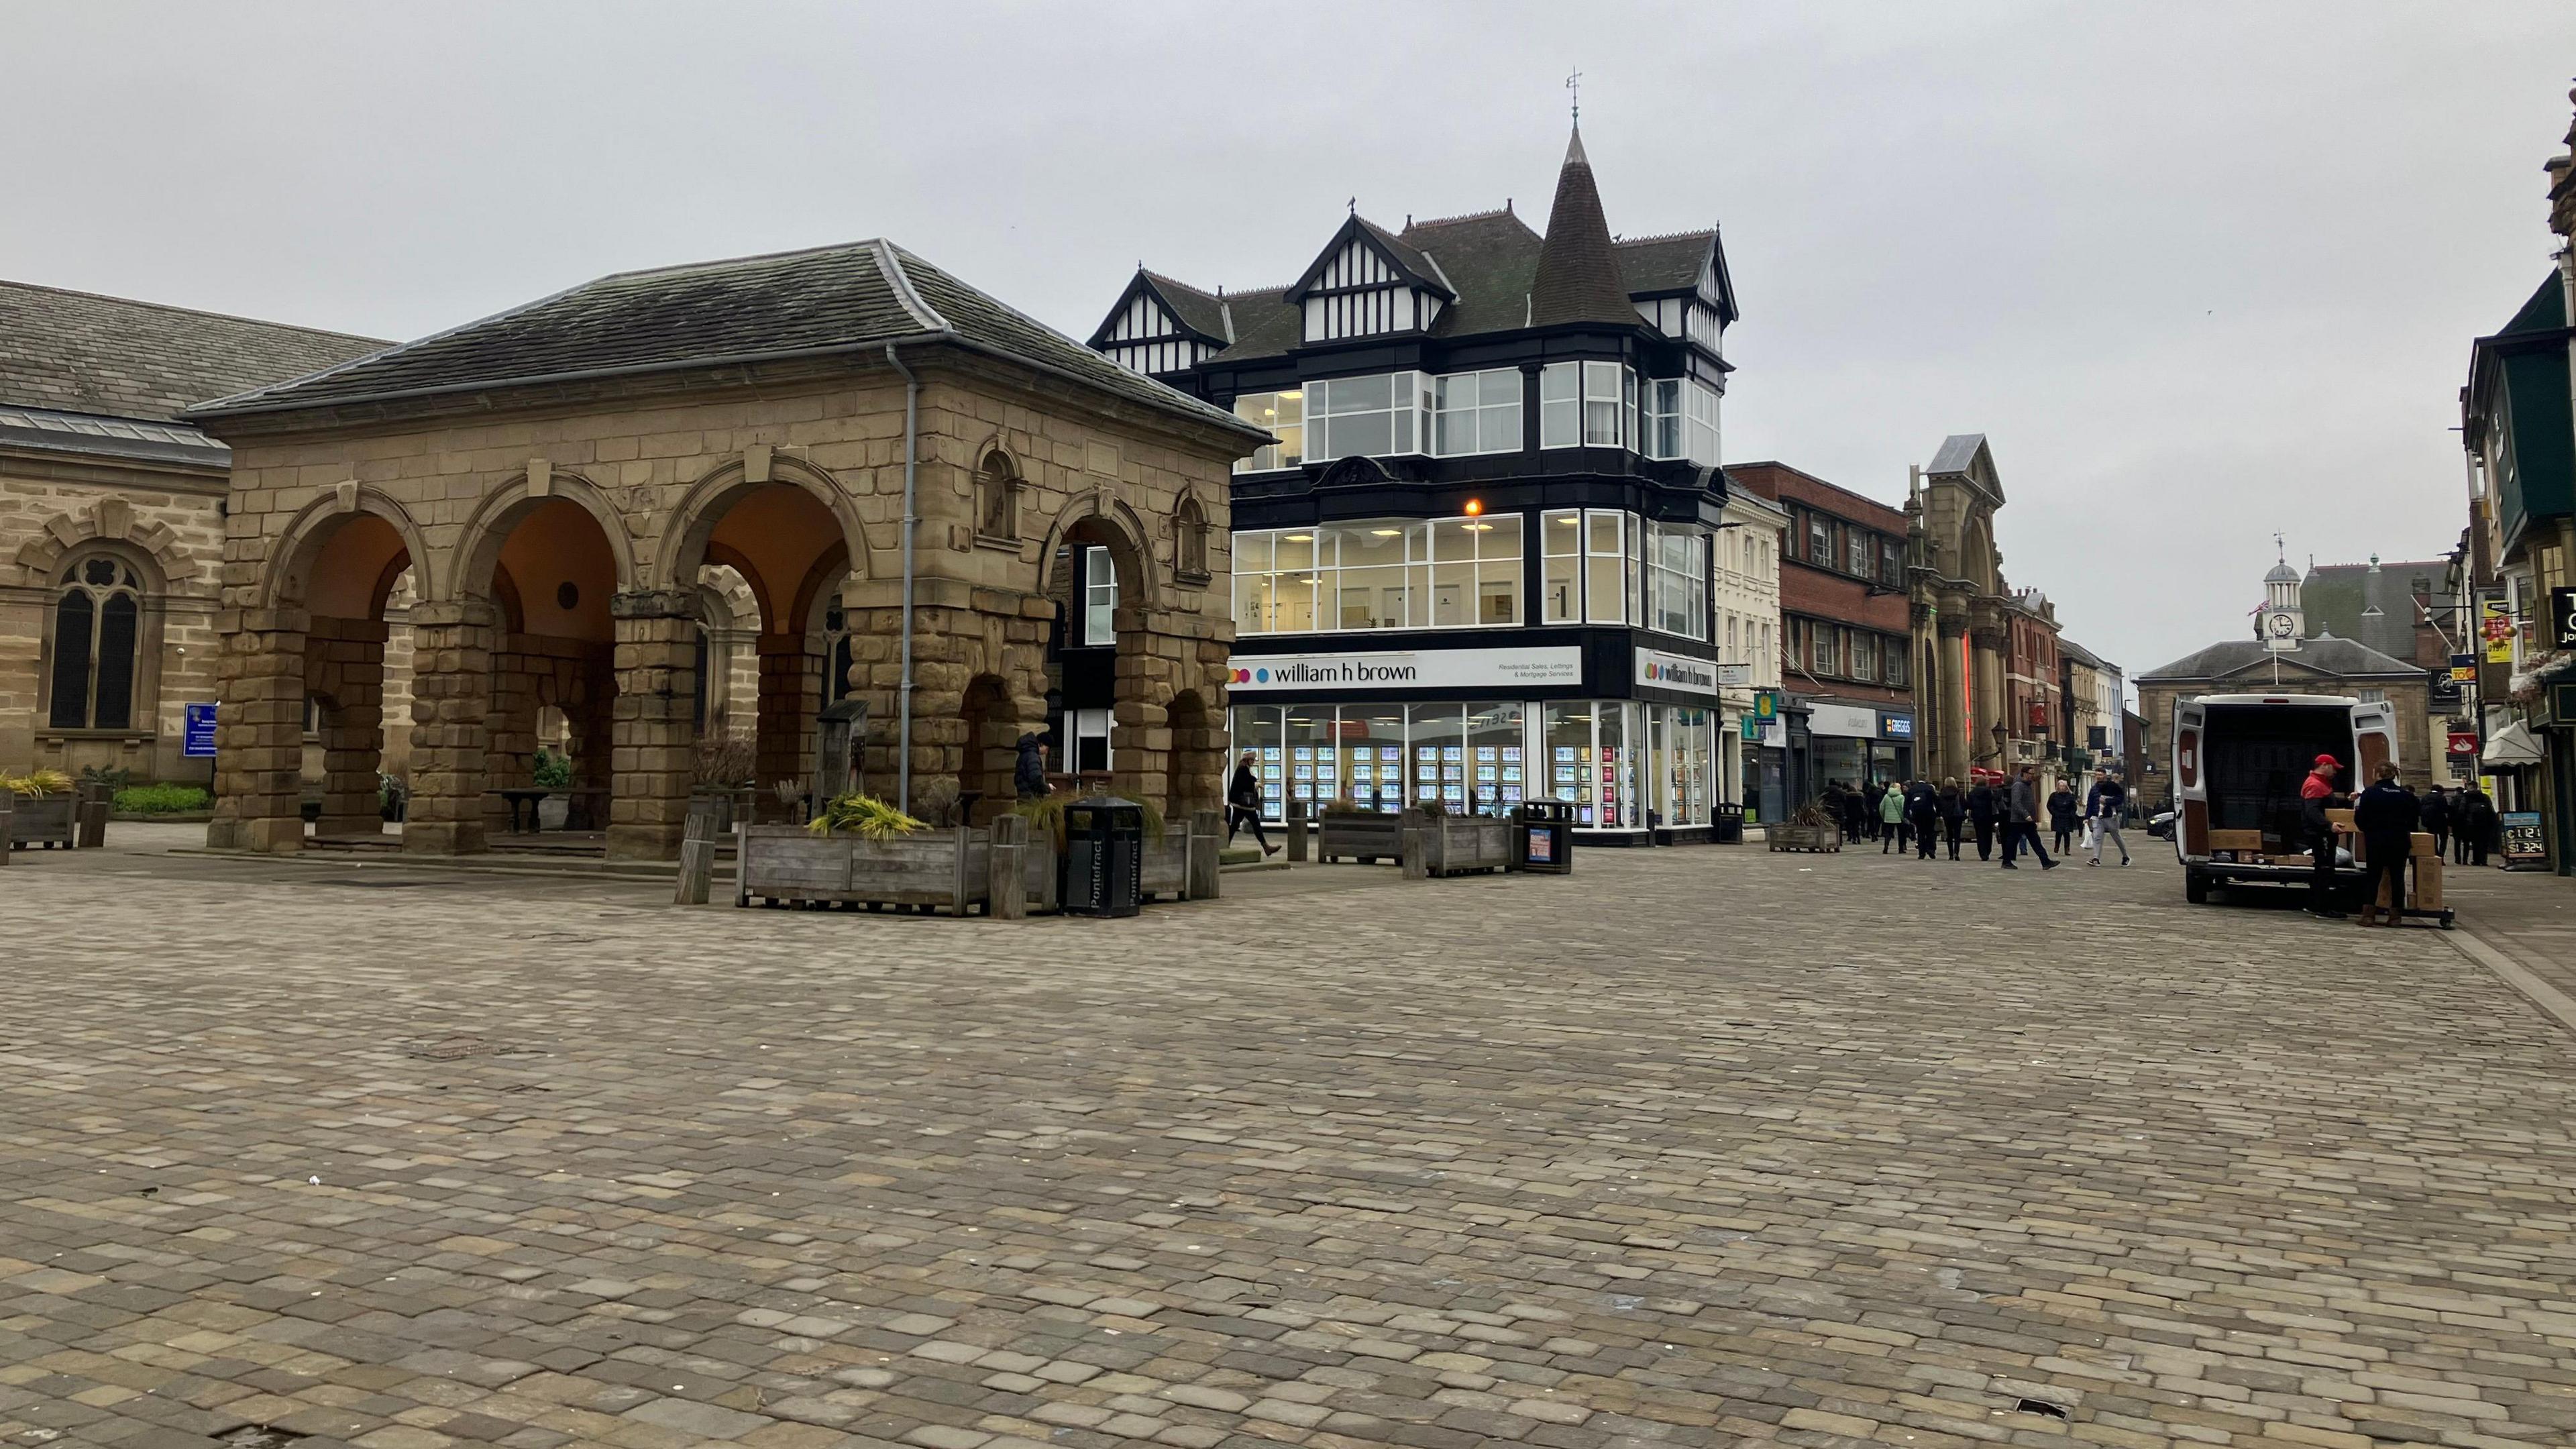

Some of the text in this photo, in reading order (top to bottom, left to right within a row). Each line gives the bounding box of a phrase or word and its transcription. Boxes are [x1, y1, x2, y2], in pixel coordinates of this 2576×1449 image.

[1275, 662, 1416, 682] william h brown
[1666, 663, 1687, 683] william
[1693, 666, 1712, 687] brown
[1892, 719, 1911, 733] GREGGS
[1091, 839, 1102, 908] Pontefract
[1130, 840, 1138, 906] Pontefract
